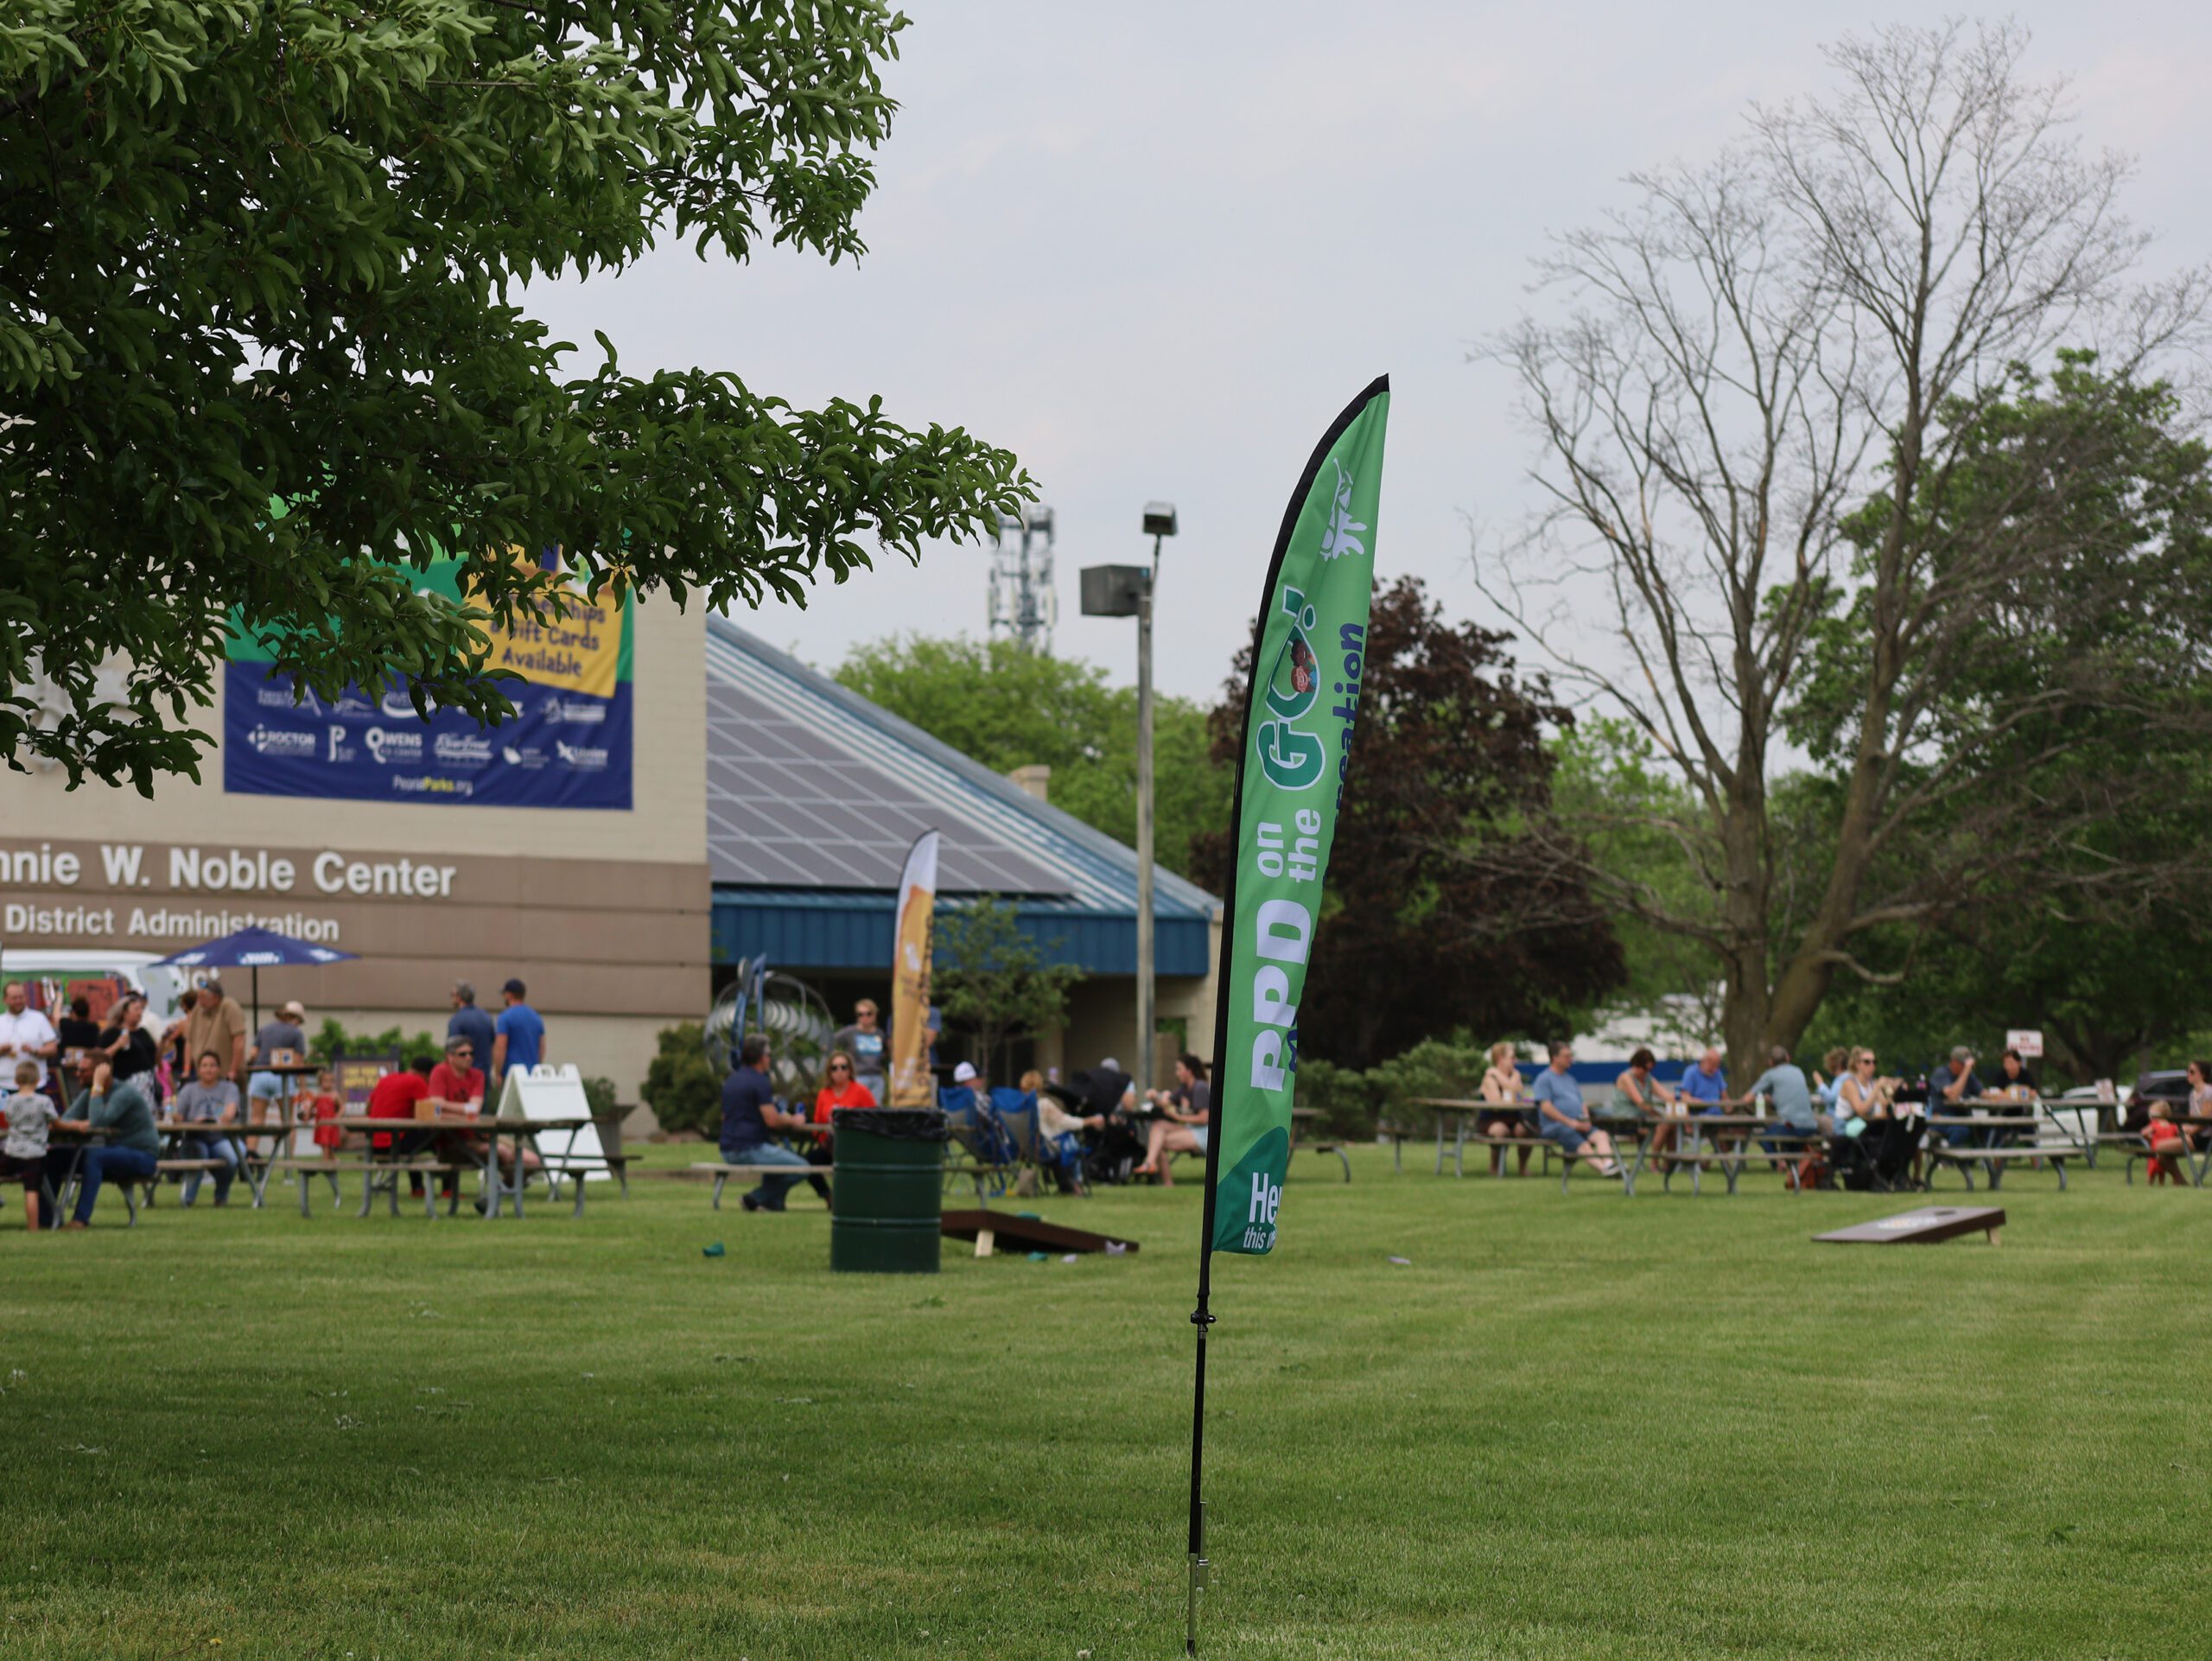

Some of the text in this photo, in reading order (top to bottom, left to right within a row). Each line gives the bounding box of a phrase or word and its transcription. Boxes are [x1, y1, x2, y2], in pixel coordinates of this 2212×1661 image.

[548, 626, 601, 652] Cards
[501, 648, 582, 677] Available
[1256, 821, 1284, 878] on
[1287, 808, 1322, 884] the
[101, 844, 151, 888] W.
[169, 848, 296, 892] Noble
[312, 850, 456, 897] Center
[5, 903, 114, 936] District
[1250, 899, 1312, 1092] PPD
[1243, 1226, 1267, 1250] this
